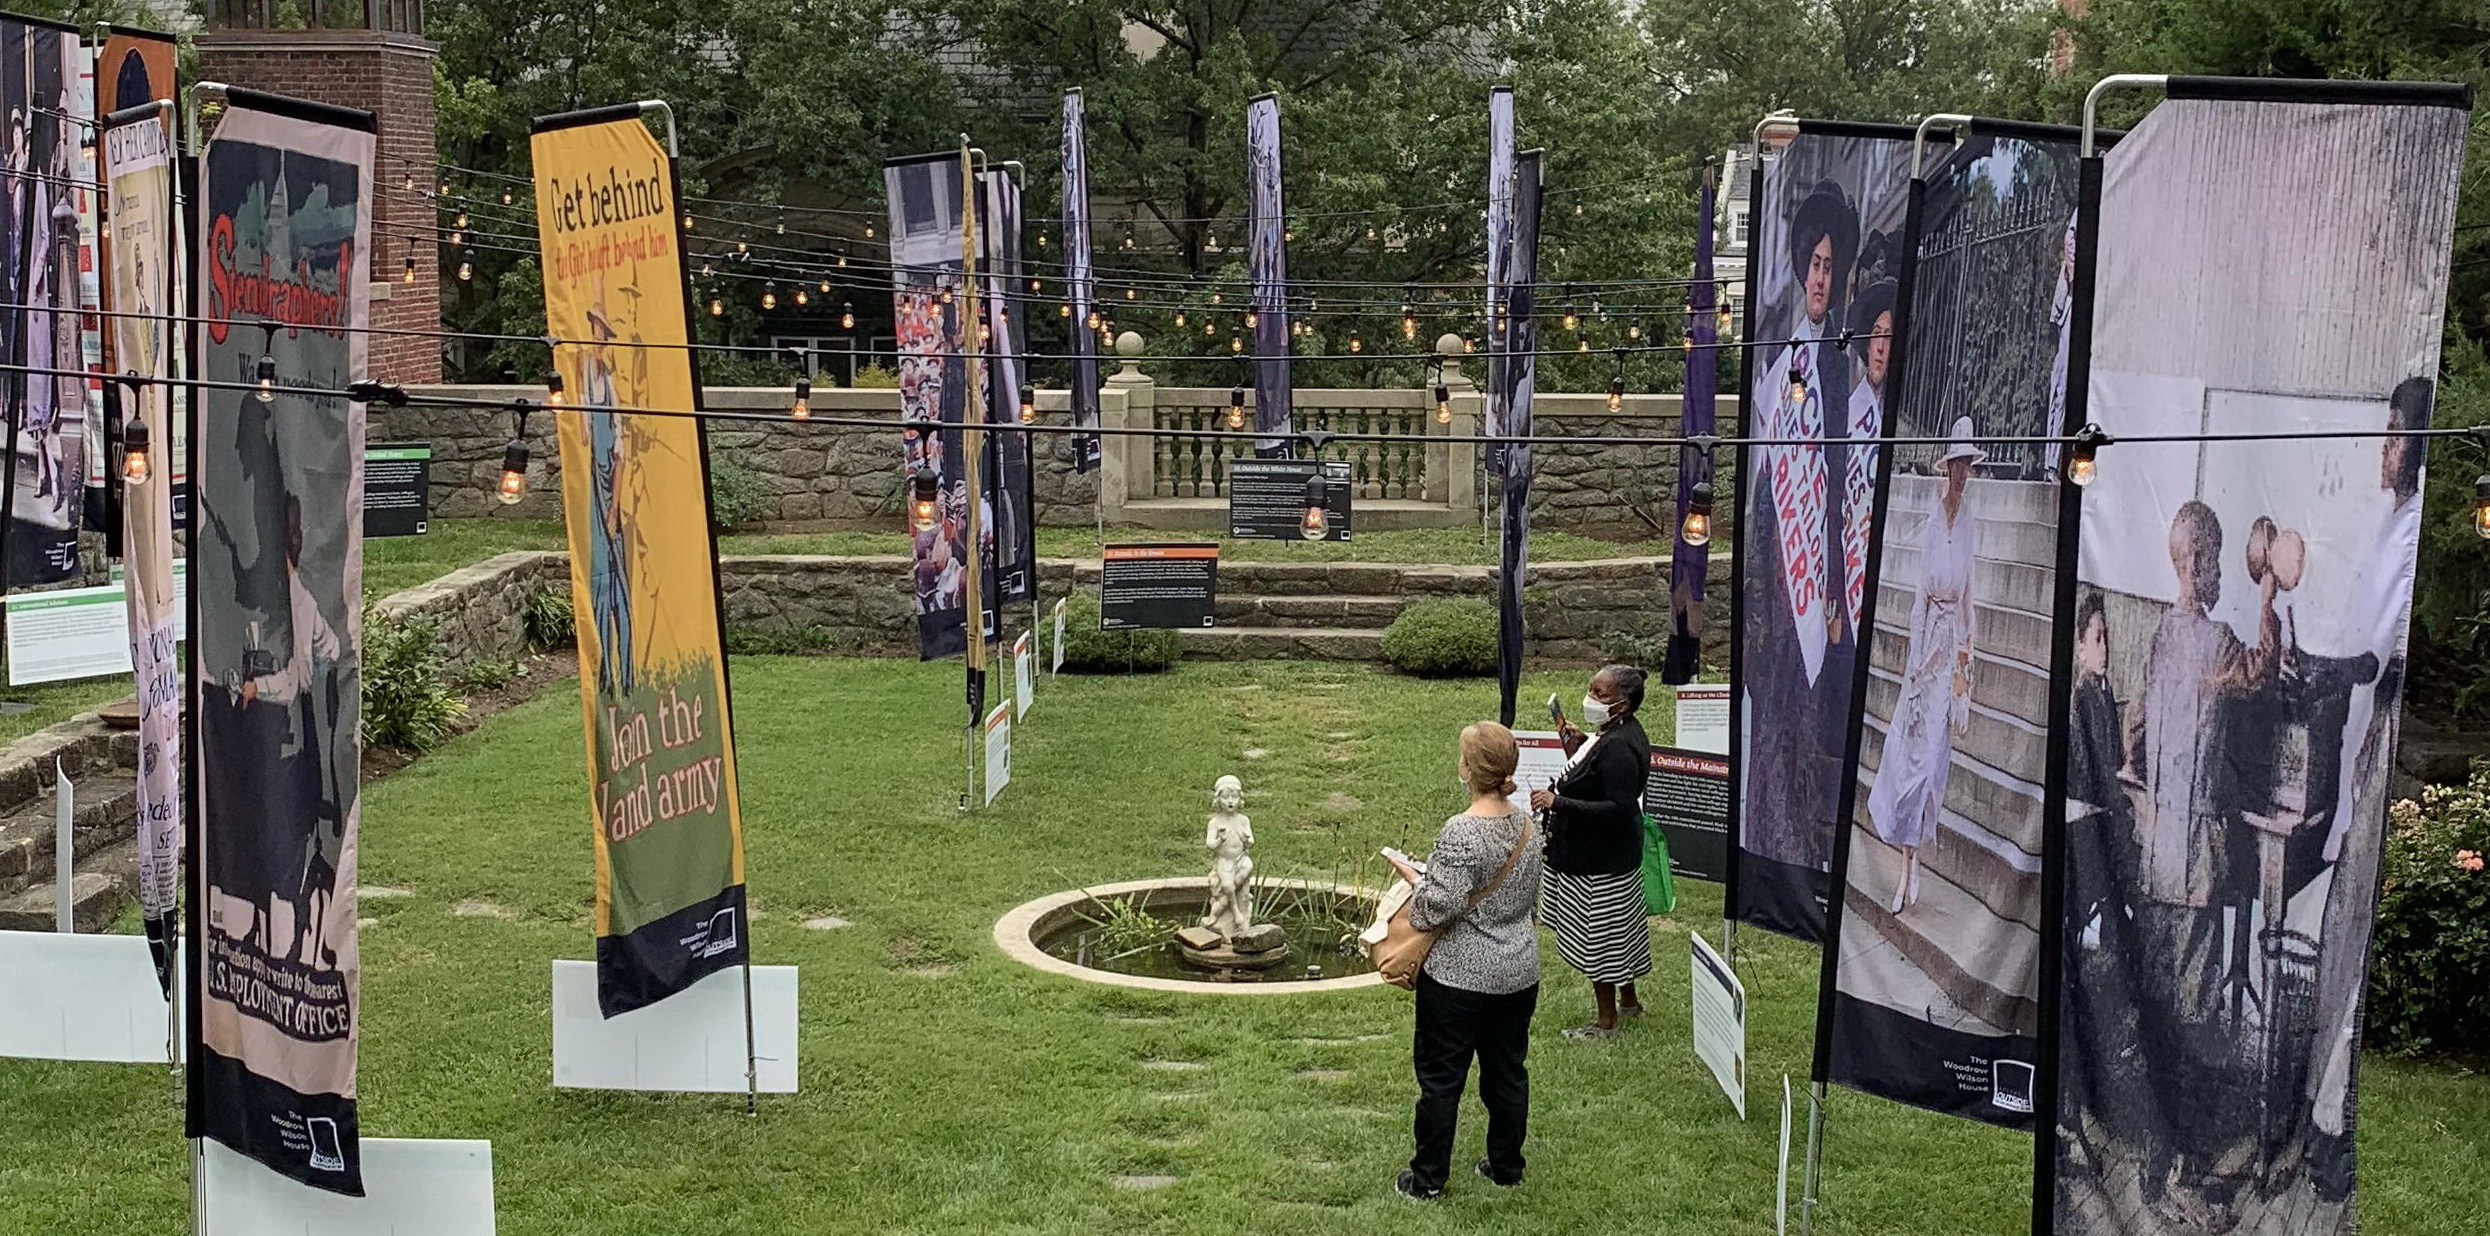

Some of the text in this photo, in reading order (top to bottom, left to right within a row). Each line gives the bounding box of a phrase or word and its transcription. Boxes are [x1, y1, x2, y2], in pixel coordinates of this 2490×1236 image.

[551, 157, 664, 233] Get behind
[608, 686, 702, 772] Join the
[1657, 756, 1686, 769] Outside
[1686, 759, 1700, 770] the
[600, 755, 722, 842] land army
[295, 1001, 349, 1035] OFFICE
[1943, 1060, 1988, 1074] Woodrow
[1970, 1055, 1988, 1065] The
[1956, 1073, 1988, 1083] Wilson
[1959, 1083, 1989, 1092] House
